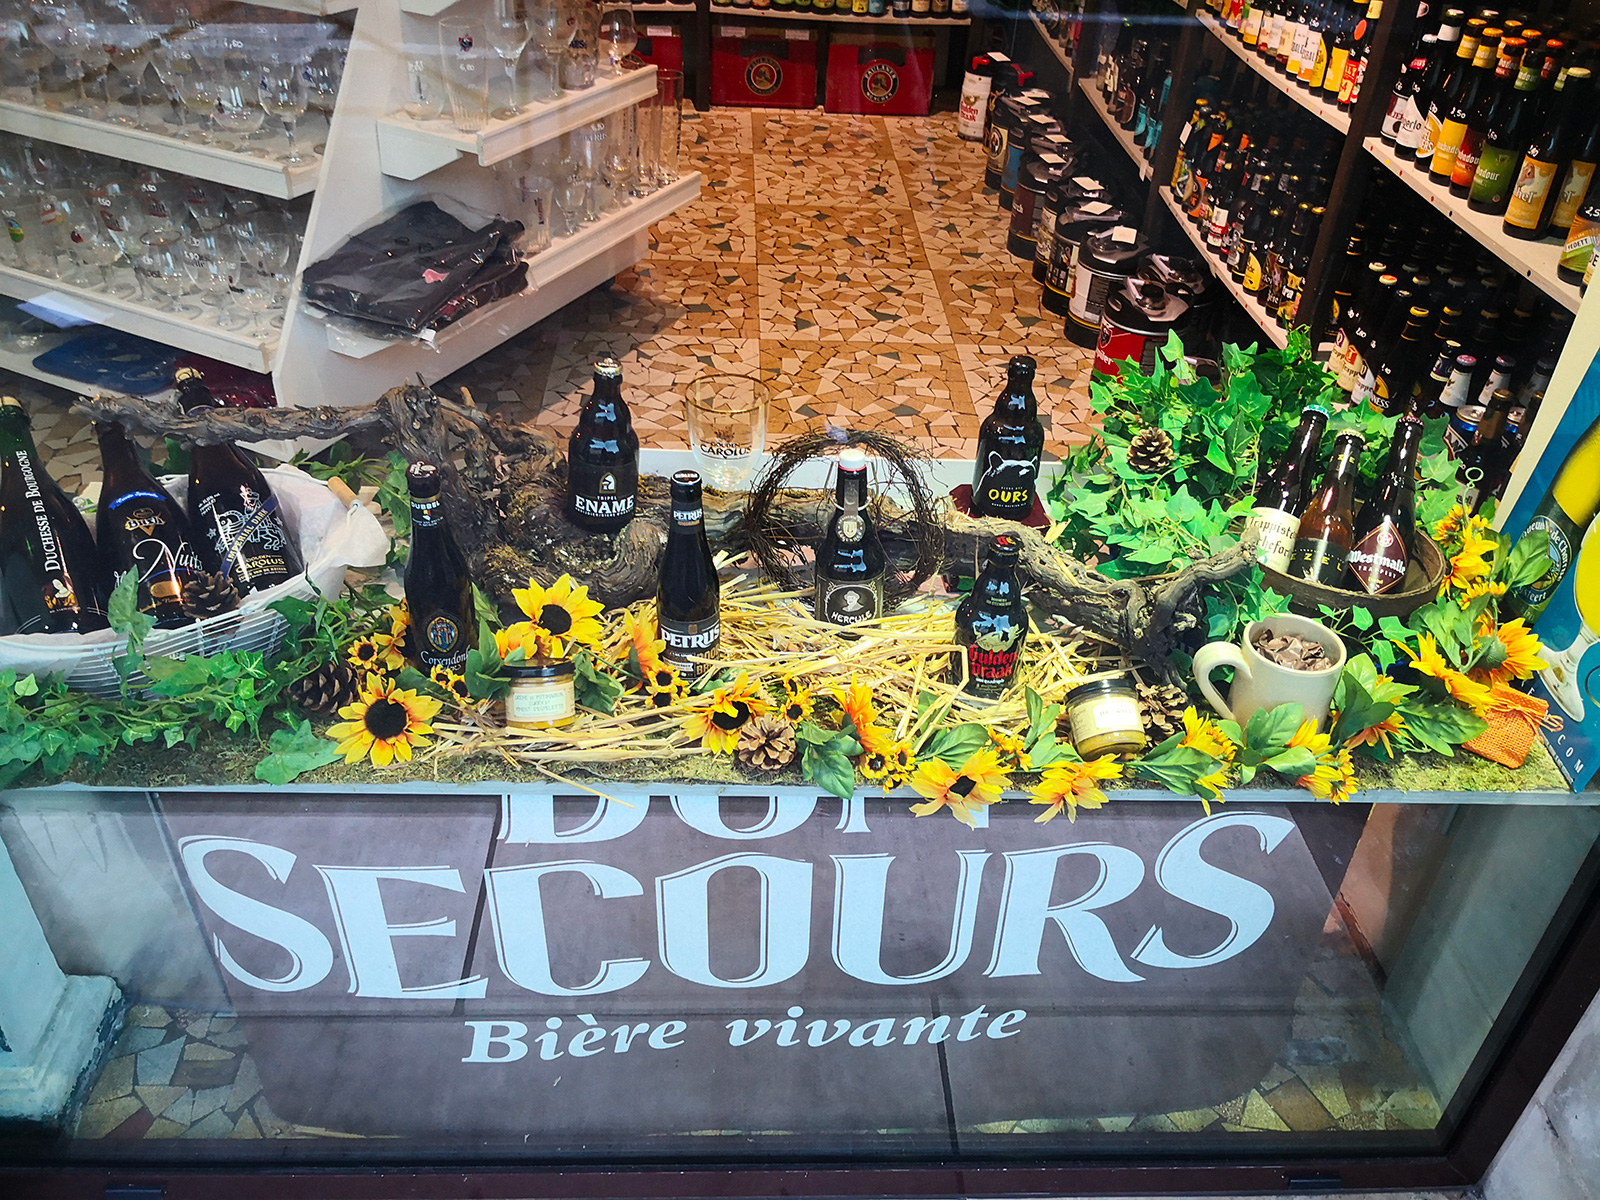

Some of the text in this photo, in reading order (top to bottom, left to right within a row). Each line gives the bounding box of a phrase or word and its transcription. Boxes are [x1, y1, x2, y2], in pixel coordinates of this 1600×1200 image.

[700, 443, 753, 459] CAROLUS
[575, 494, 635, 515] ENAME
[988, 489, 1028, 503] OURS
[15, 449, 61, 572] DUCHESSE DE BOURGOGNE
[673, 508, 703, 521] PETRUS
[226, 525, 255, 563] IMPERIAL
[251, 508, 269, 528] DARK
[1551, 530, 1562, 544] de
[132, 538, 203, 583] Nuits
[1349, 549, 1407, 577] Westmalle
[831, 610, 872, 625] HERCULE
[660, 625, 720, 649] PETRUS
[969, 643, 1018, 666] Gulden
[971, 662, 1013, 679] Draak
[177, 811, 1296, 1000] SECOURS
[461, 1004, 1028, 1064] Bière vivante
